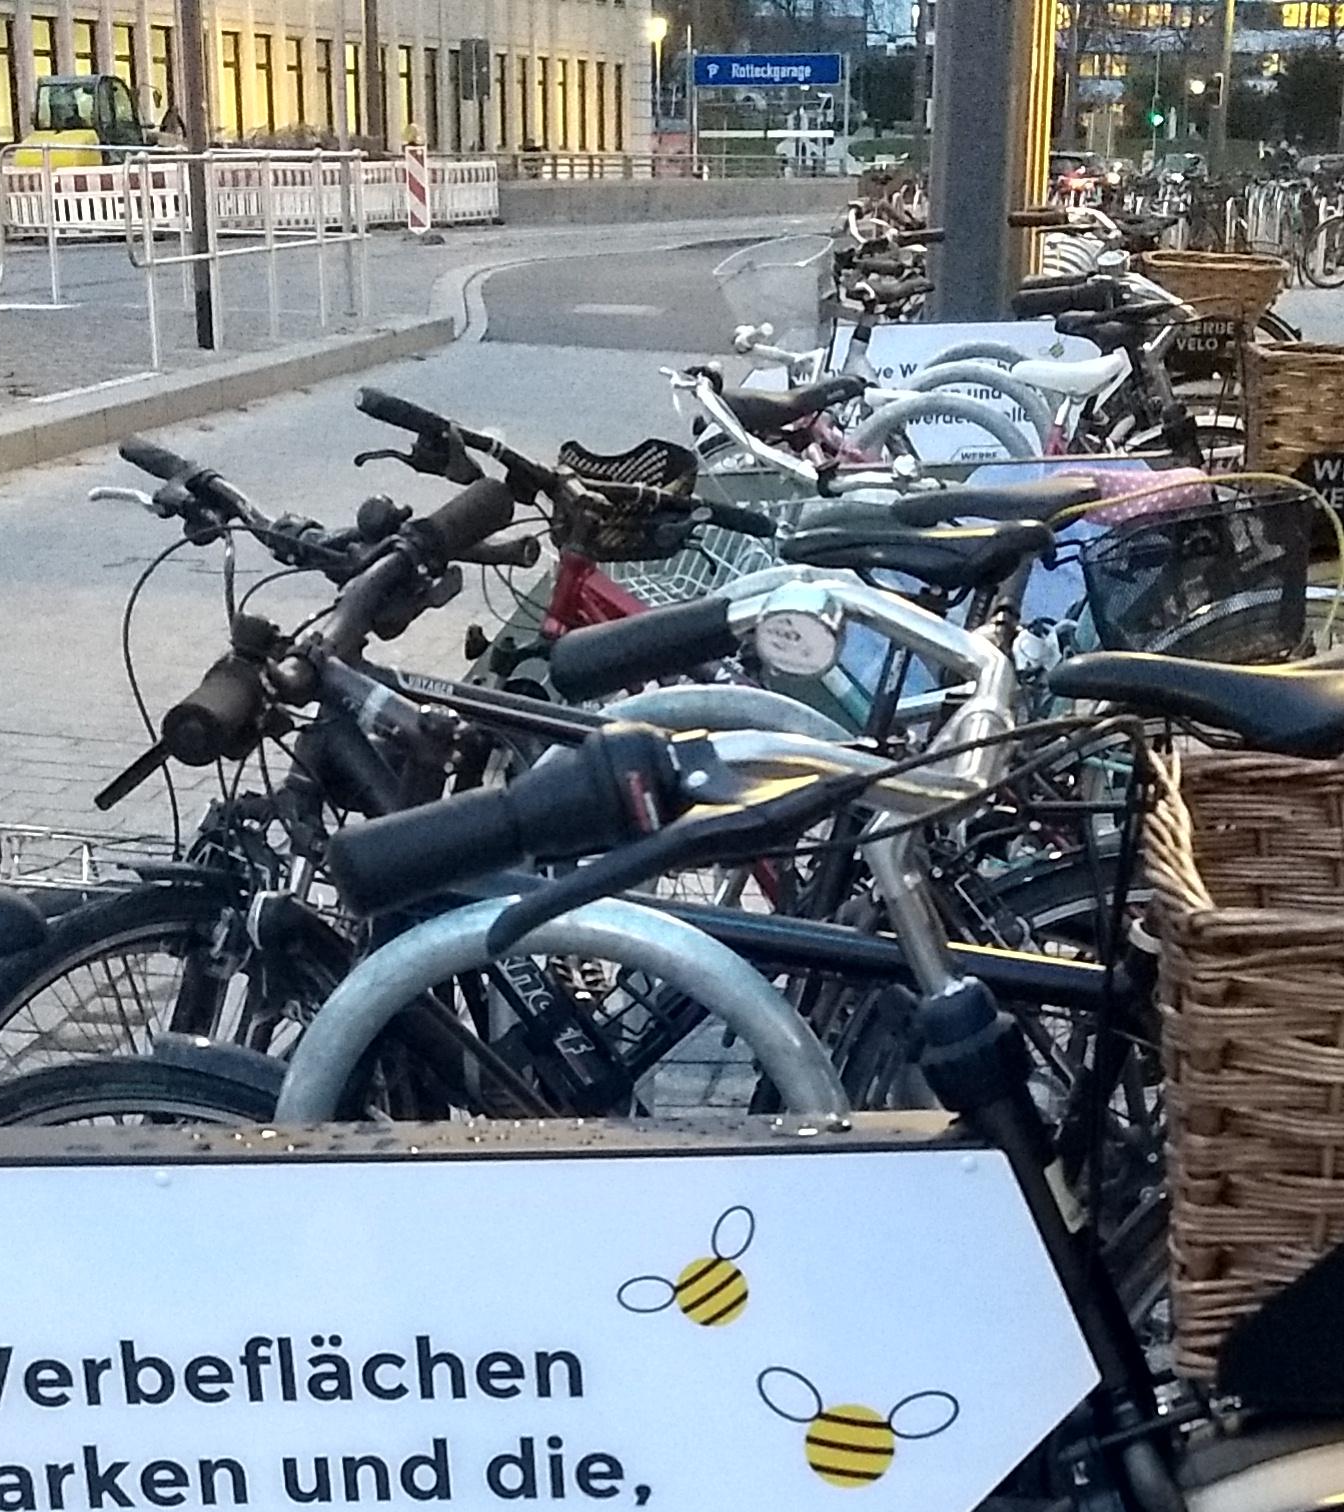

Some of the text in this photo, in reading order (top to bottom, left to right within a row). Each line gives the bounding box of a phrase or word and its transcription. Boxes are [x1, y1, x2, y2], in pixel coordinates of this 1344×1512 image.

[1177, 338, 1218, 351] VELO
[282, 1437, 452, 1503] und
[486, 1435, 652, 1506] die,
